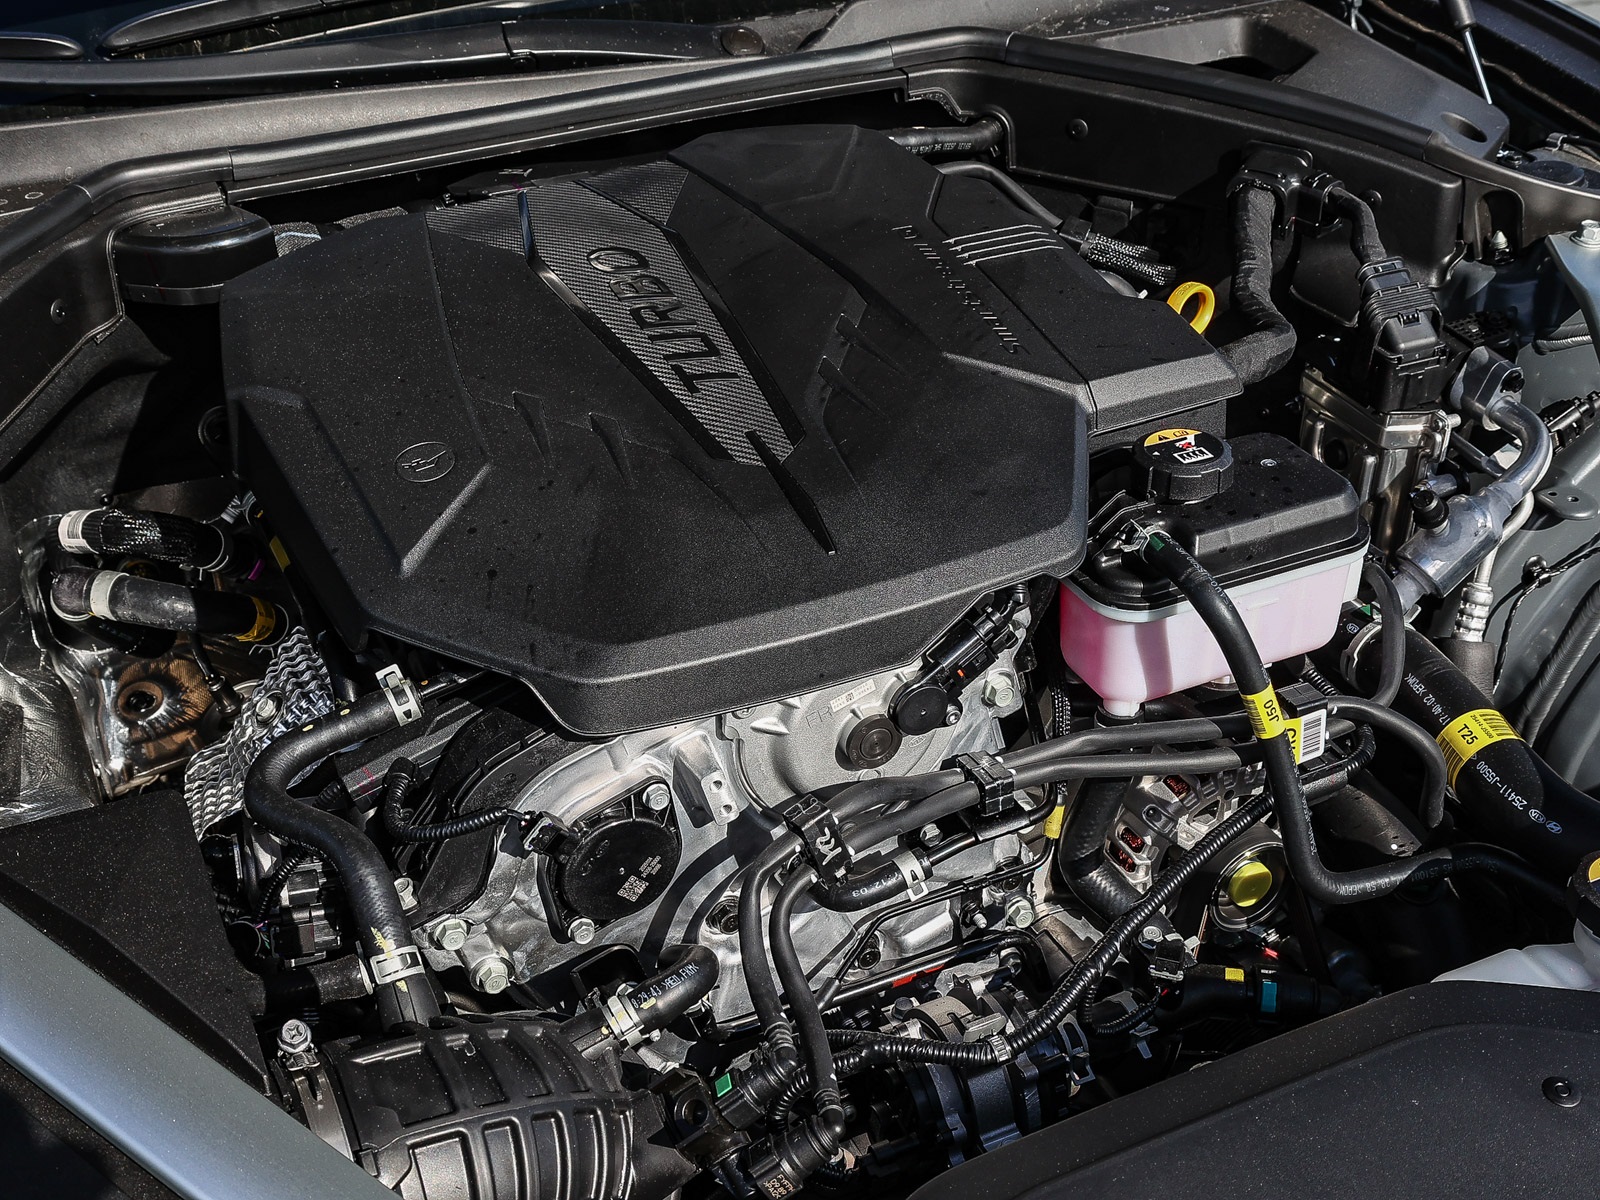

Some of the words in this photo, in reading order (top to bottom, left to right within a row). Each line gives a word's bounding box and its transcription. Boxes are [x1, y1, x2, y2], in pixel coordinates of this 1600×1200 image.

[587, 247, 741, 395] TURBO
[1264, 699, 1280, 723] J50
[1456, 722, 1479, 746] T25
[1476, 761, 1528, 811] 25411-J5500
[1528, 809, 1547, 825] KIA
